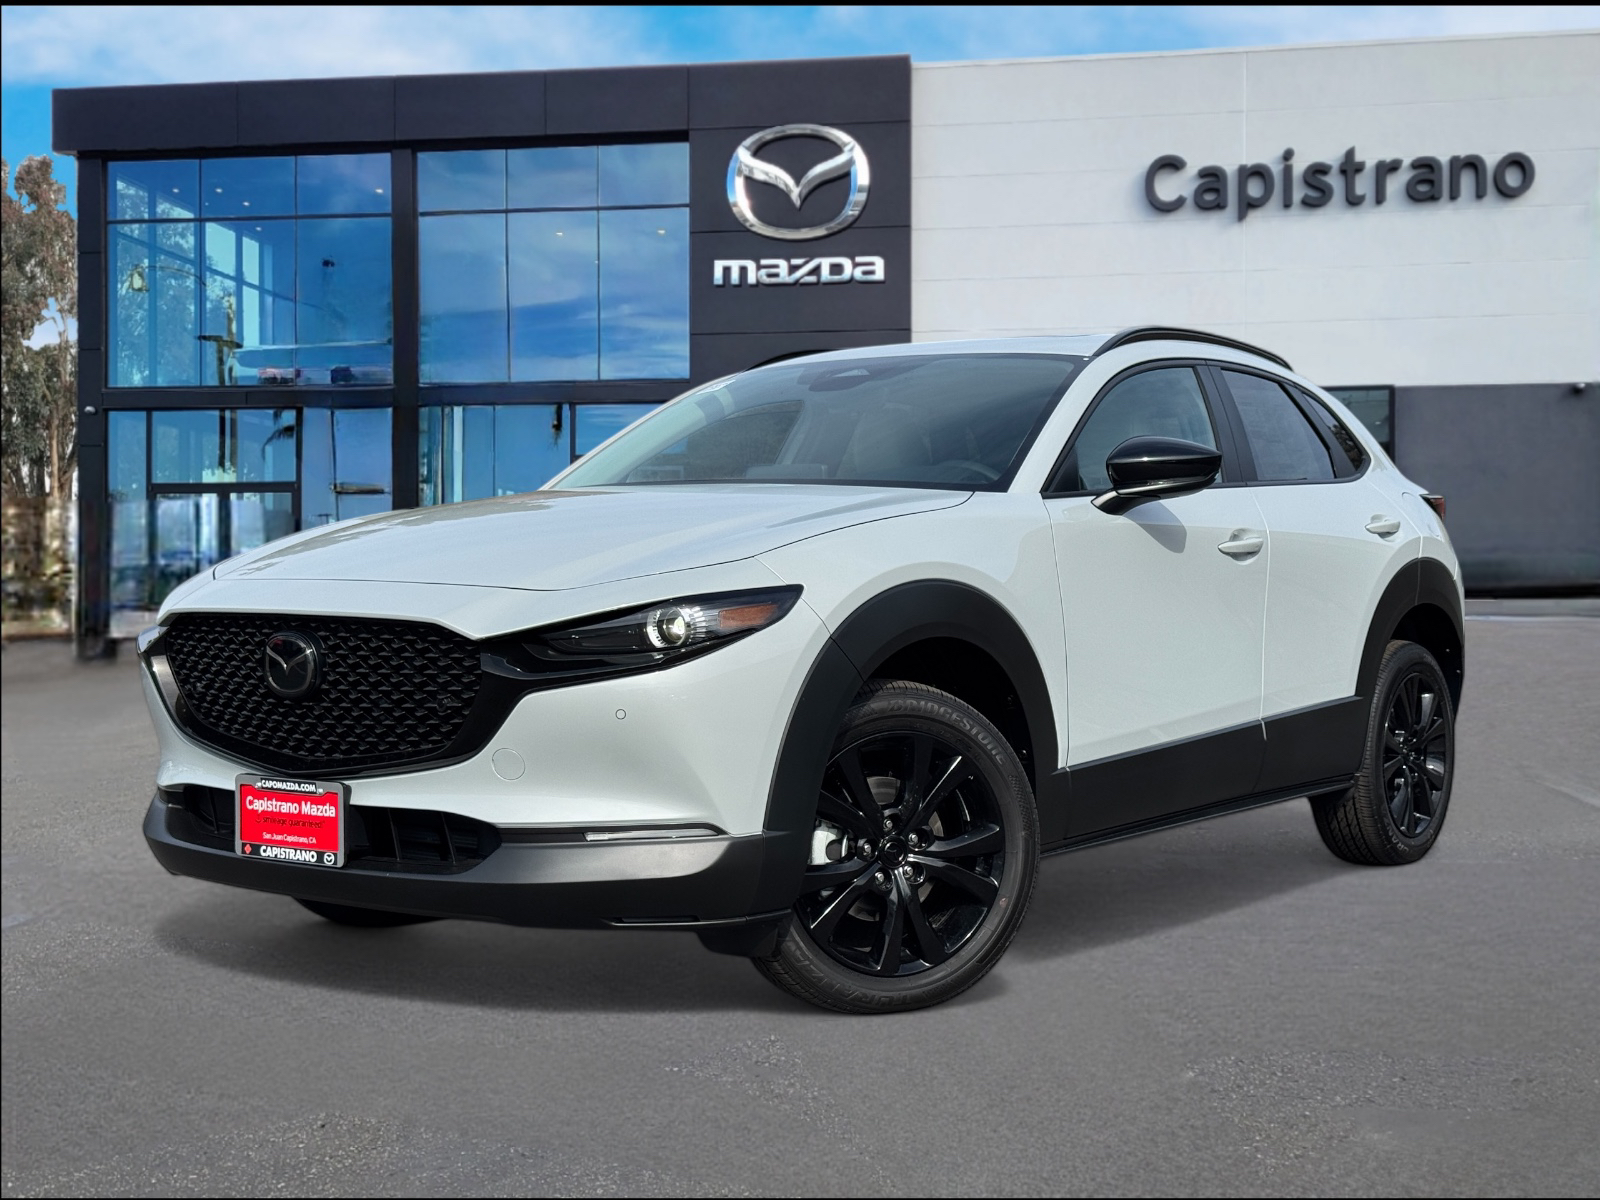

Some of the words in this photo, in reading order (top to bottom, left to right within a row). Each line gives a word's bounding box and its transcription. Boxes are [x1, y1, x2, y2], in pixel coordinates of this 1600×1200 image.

[1145, 146, 1535, 222] Capistrano
[888, 700, 1006, 766] BRIDGESTONE
[261, 780, 317, 793] CAPOMAZDA.COM
[246, 795, 299, 814] Capistrano
[301, 801, 336, 817] Mazda
[262, 832, 272, 840] San
[272, 833, 284, 841] Juan
[309, 836, 317, 844] CA
[260, 845, 317, 862] CAPISTRANO
